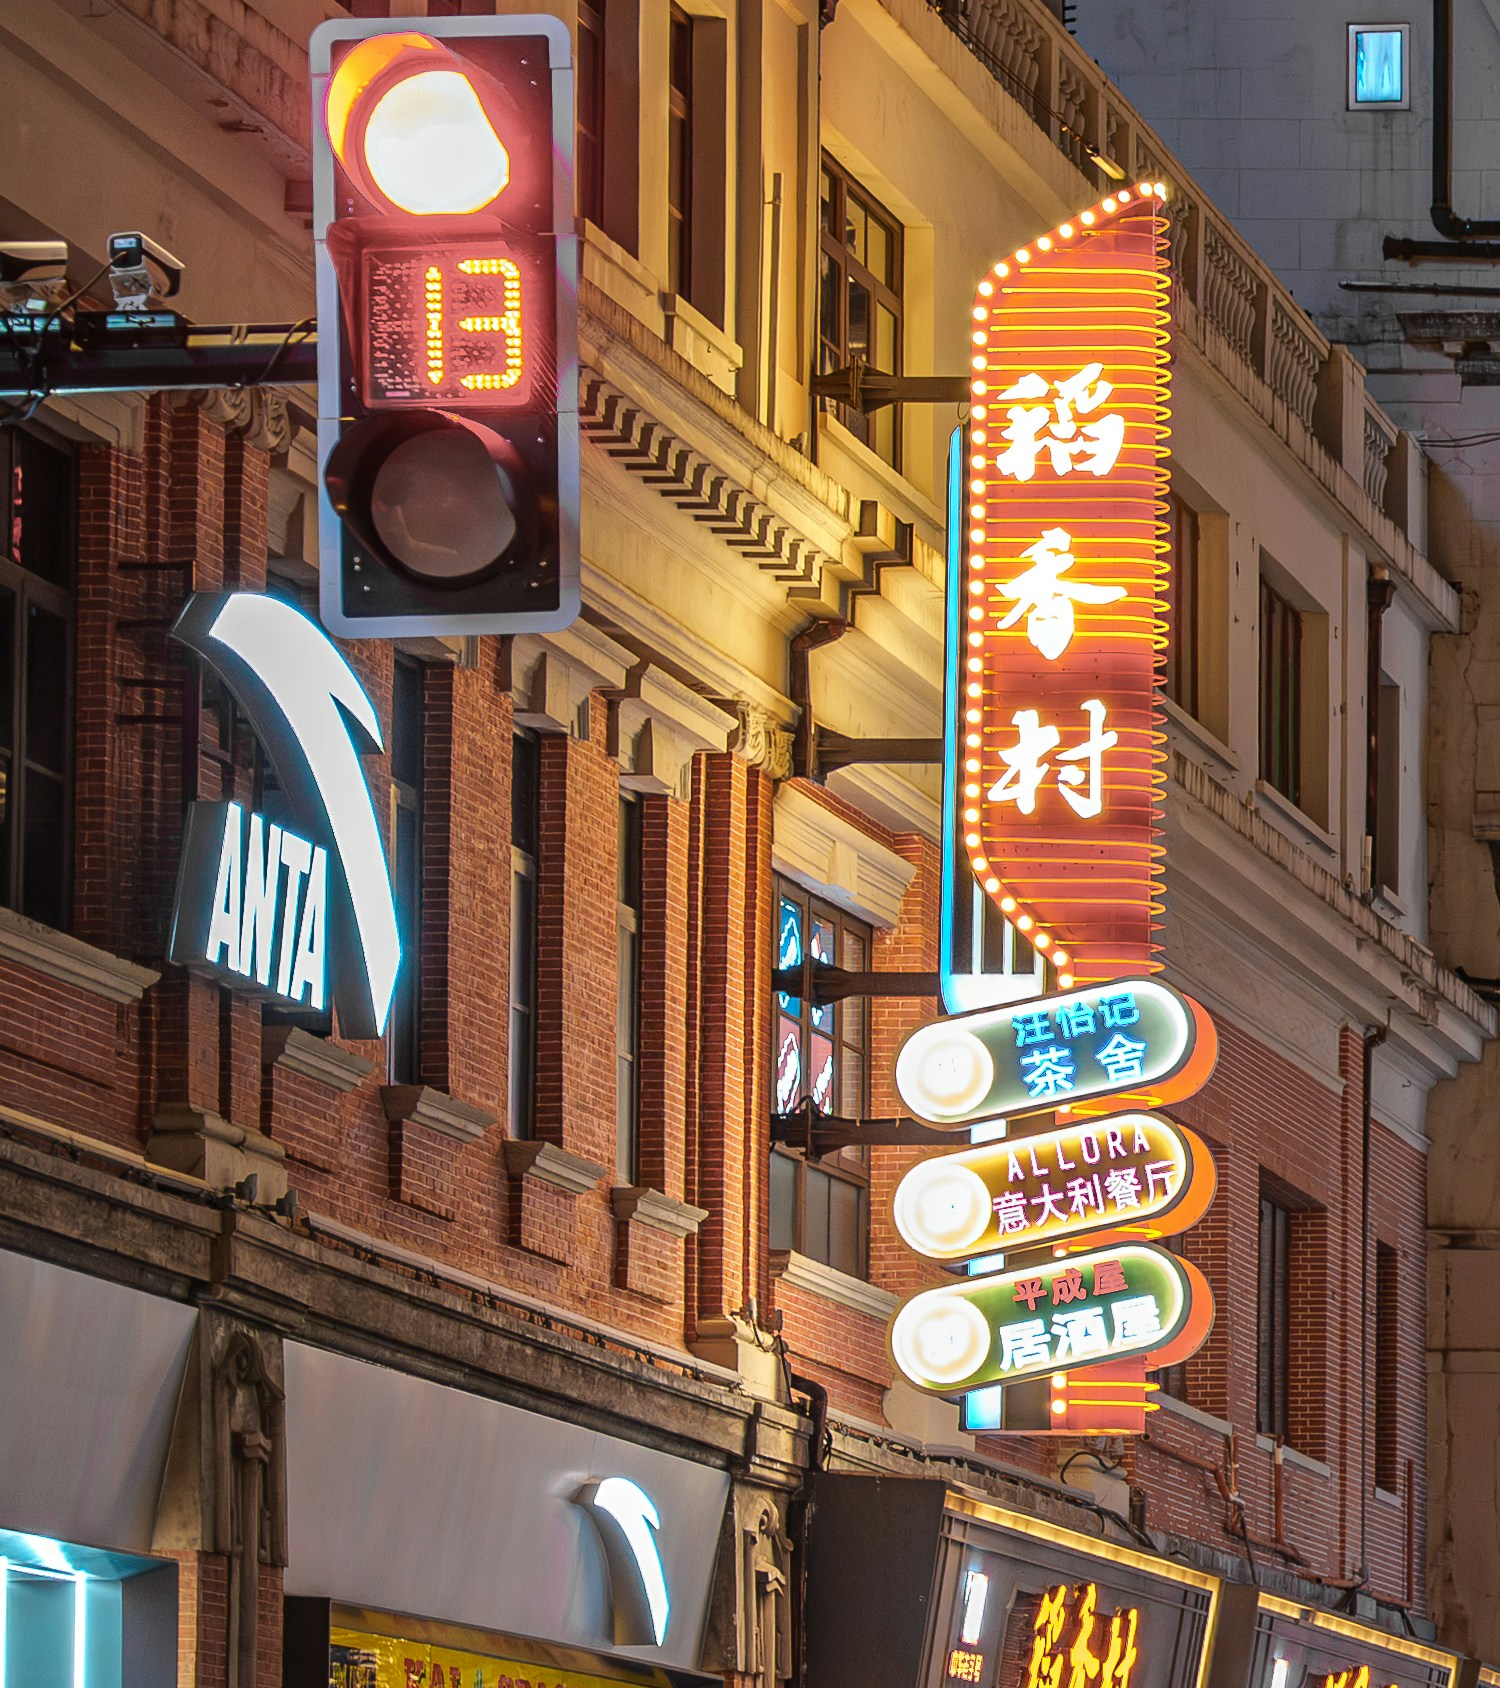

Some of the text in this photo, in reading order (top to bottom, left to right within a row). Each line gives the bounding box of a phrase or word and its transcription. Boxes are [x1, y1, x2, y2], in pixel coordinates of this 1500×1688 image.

[425, 258, 522, 390] 13
[986, 361, 1130, 820] 稻香村
[205, 800, 328, 1012] ANTA
[1012, 993, 1142, 1049] 汪怡记
[1020, 1033, 1148, 1098] 茶舍
[1007, 1128, 1152, 1182] ALLORA
[992, 1160, 1178, 1236] 意大利餐厅
[1012, 1259, 1130, 1312] 平成屋
[999, 1295, 1163, 1371] 居酒屋
